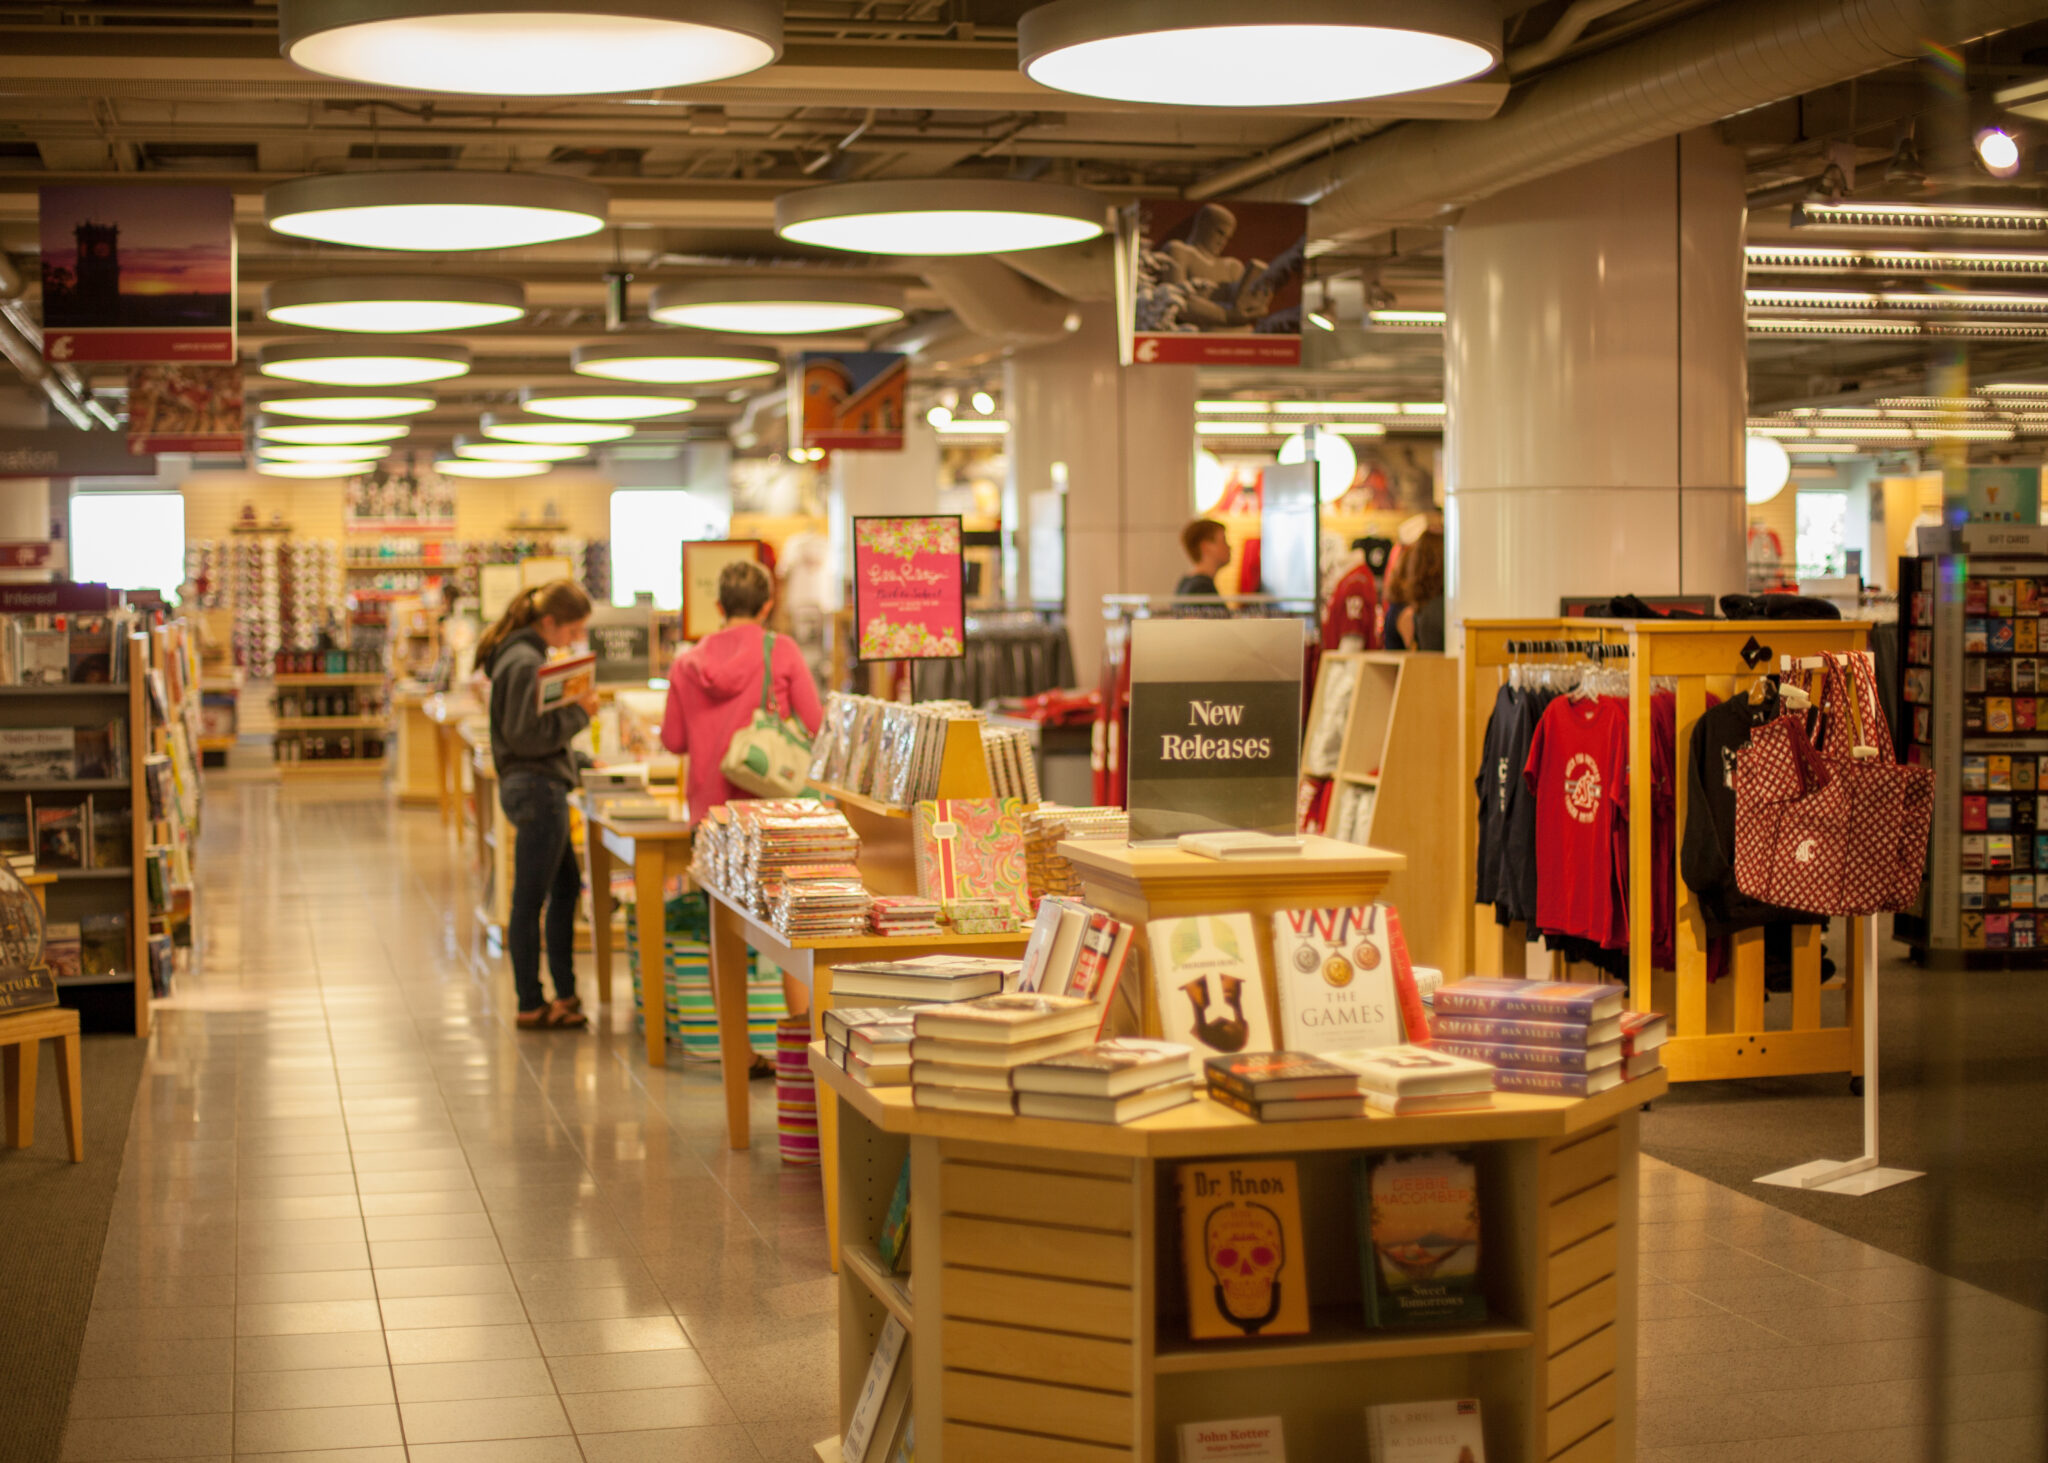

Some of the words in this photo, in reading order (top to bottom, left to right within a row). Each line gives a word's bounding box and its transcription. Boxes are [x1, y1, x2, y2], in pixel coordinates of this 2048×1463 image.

[1189, 700, 1244, 726] New
[1160, 734, 1271, 760] Releases
[1326, 990, 1357, 1003] THE
[1442, 994, 1498, 1011] SMOKE
[1506, 1001, 1528, 1012] DAN
[1301, 1004, 1384, 1028] GAMES
[1438, 1020, 1494, 1035] SMOKE
[1501, 1026, 1522, 1037] DAN
[1501, 1050, 1522, 1061] DAN
[1502, 1074, 1522, 1085] DAN
[1229, 1170, 1285, 1196] Knox
[1392, 1177, 1449, 1192] DEBBIE
[1375, 1189, 1470, 1206] MACOMBER
[1197, 1431, 1227, 1443] John
[1230, 1429, 1270, 1441] Kotter
